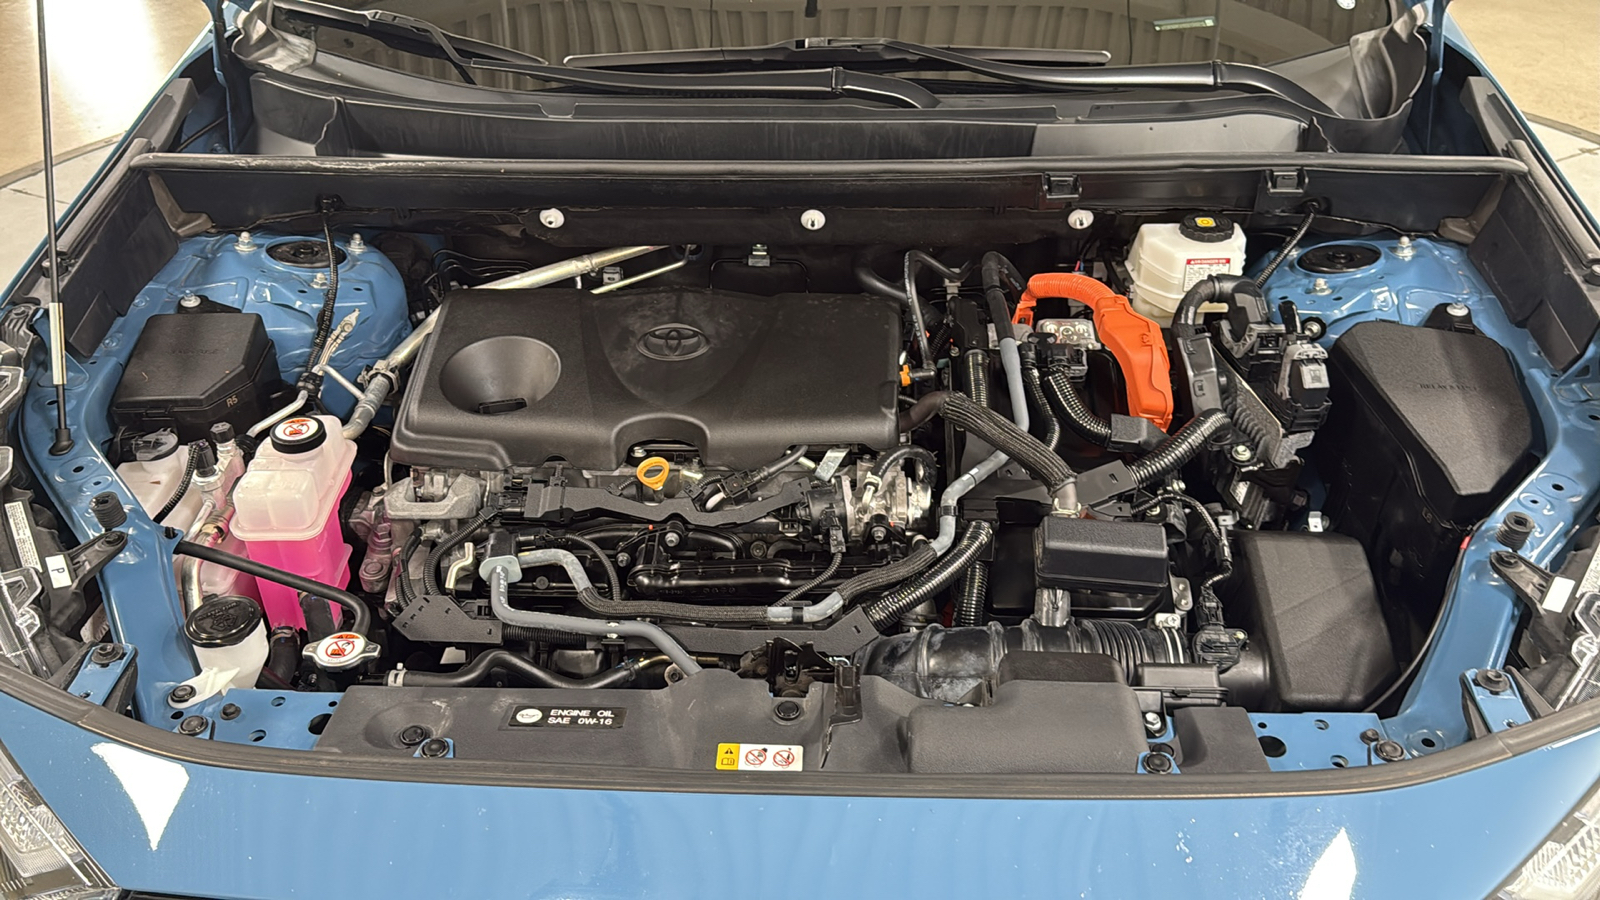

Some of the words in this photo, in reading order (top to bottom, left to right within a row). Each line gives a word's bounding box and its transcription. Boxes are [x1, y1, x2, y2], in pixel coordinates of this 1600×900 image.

[226, 395, 238, 407] R5
[550, 709, 591, 717] ENGINE
[596, 709, 615, 718] OIL
